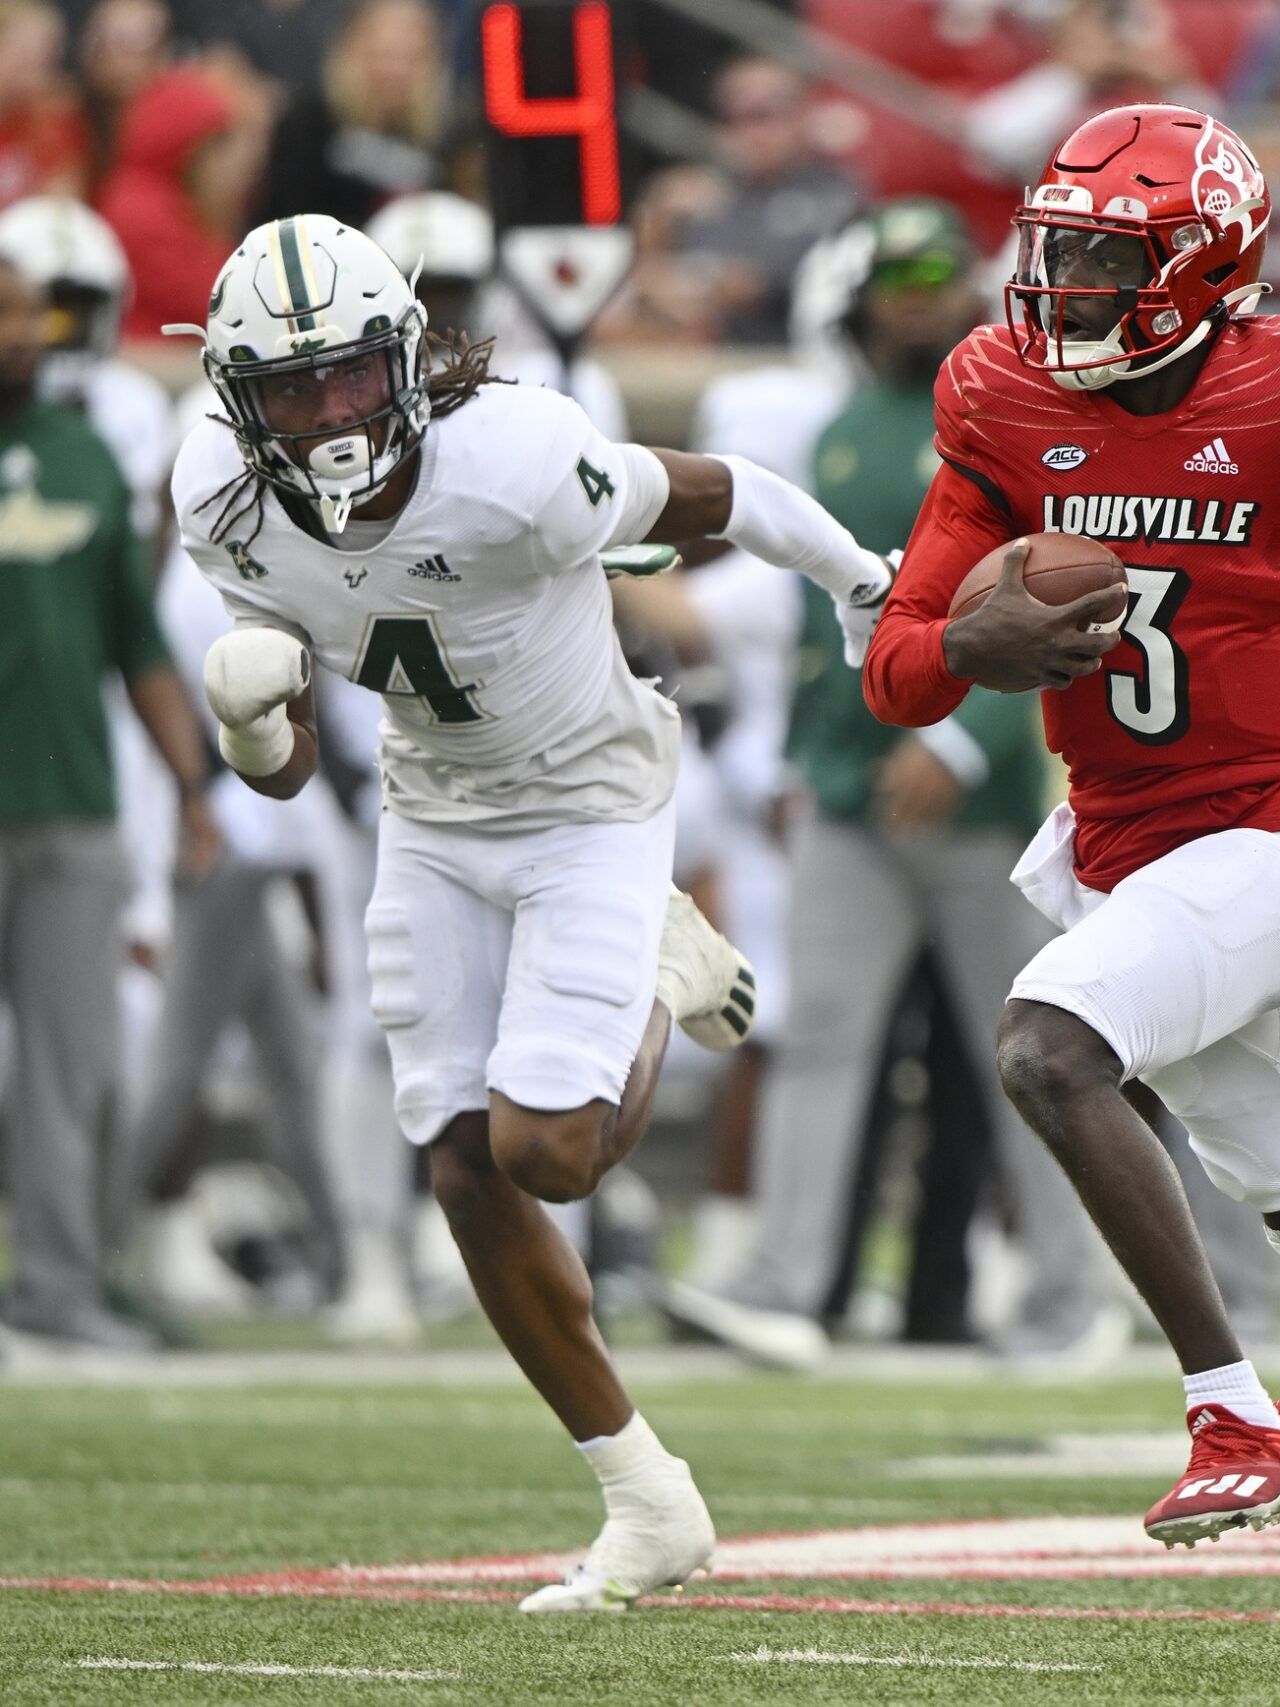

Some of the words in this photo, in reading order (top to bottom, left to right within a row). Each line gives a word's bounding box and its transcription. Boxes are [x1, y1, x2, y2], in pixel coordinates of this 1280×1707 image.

[481, 1, 622, 230] 4
[1046, 448, 1081, 462] ACC
[1184, 458, 1239, 475] adidas
[576, 455, 616, 507] 4
[1042, 494, 1256, 543] LOUISVILLE
[407, 567, 462, 583] adidas
[354, 614, 492, 725] 4
[1109, 565, 1186, 740] 3
